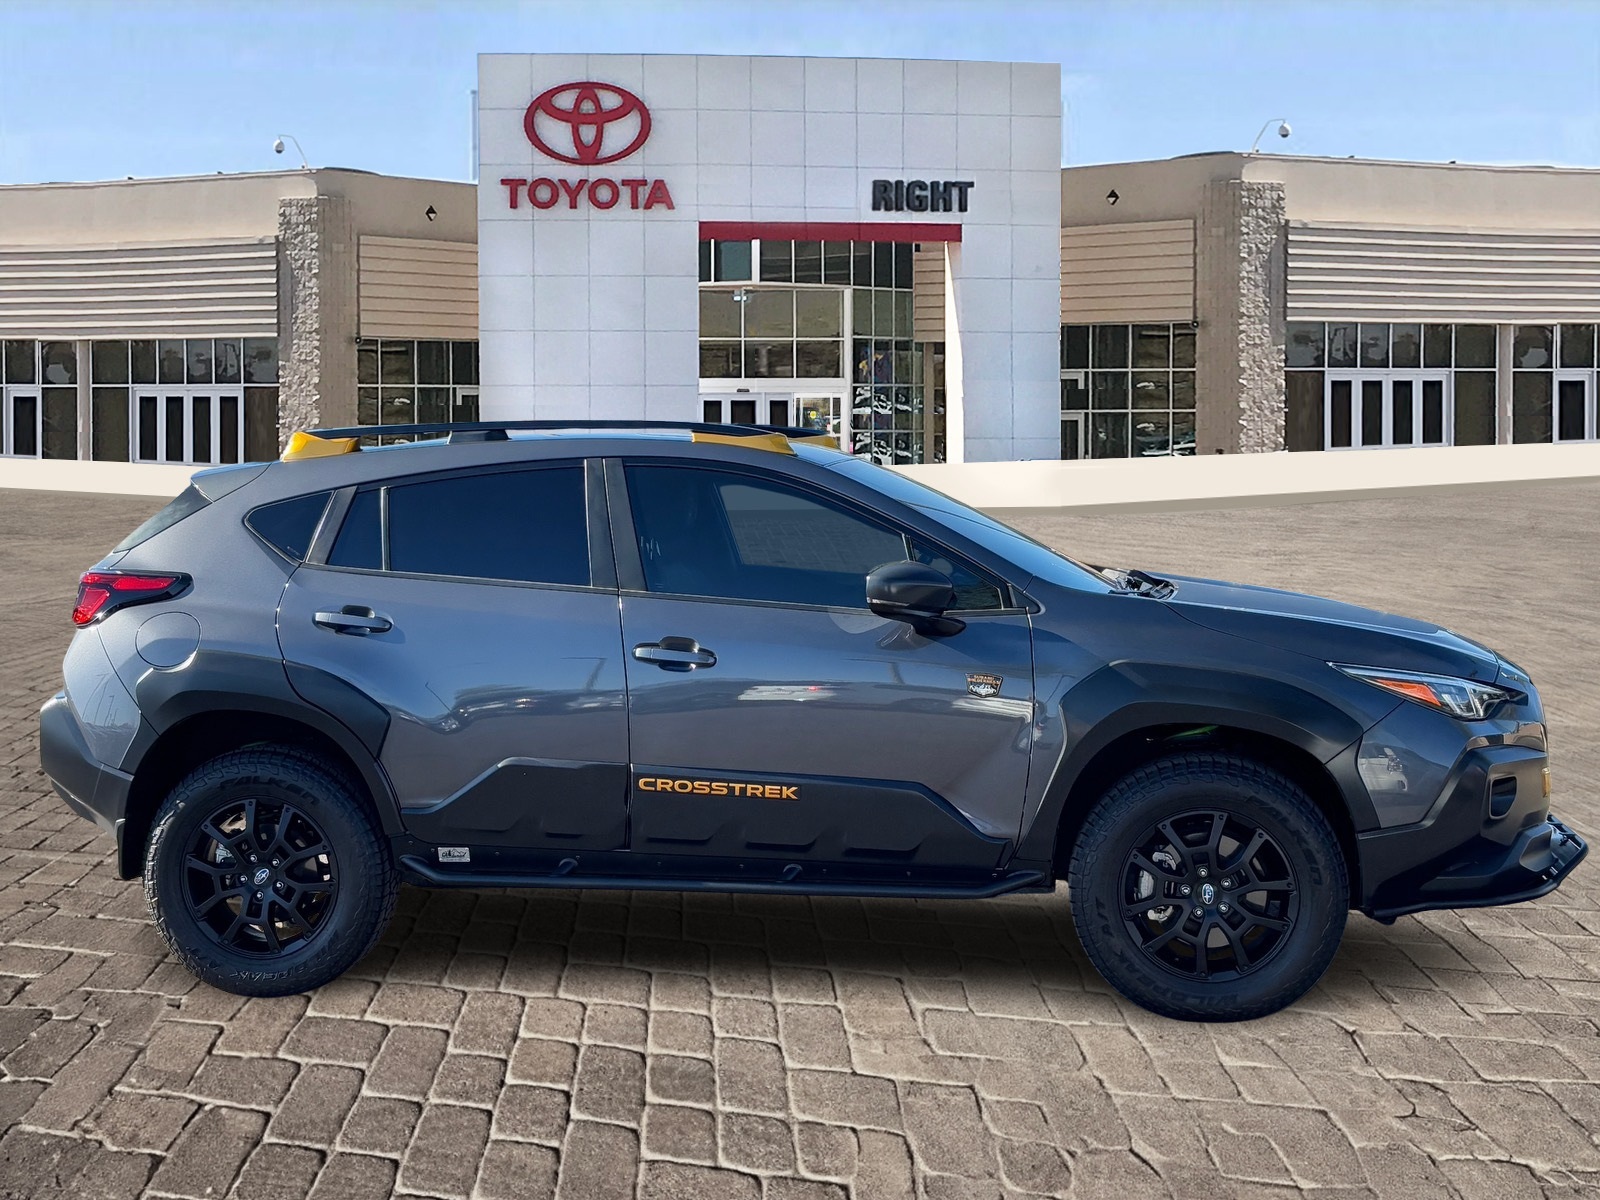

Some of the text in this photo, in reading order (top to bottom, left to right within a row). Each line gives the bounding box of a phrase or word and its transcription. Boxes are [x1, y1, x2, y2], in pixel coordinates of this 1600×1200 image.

[501, 178, 675, 210] TOYOTA
[871, 179, 975, 213] RIGHT
[219, 776, 320, 805] FALKEN
[638, 777, 799, 800] CROSSTREK
[1243, 796, 1323, 885] FALKEN
